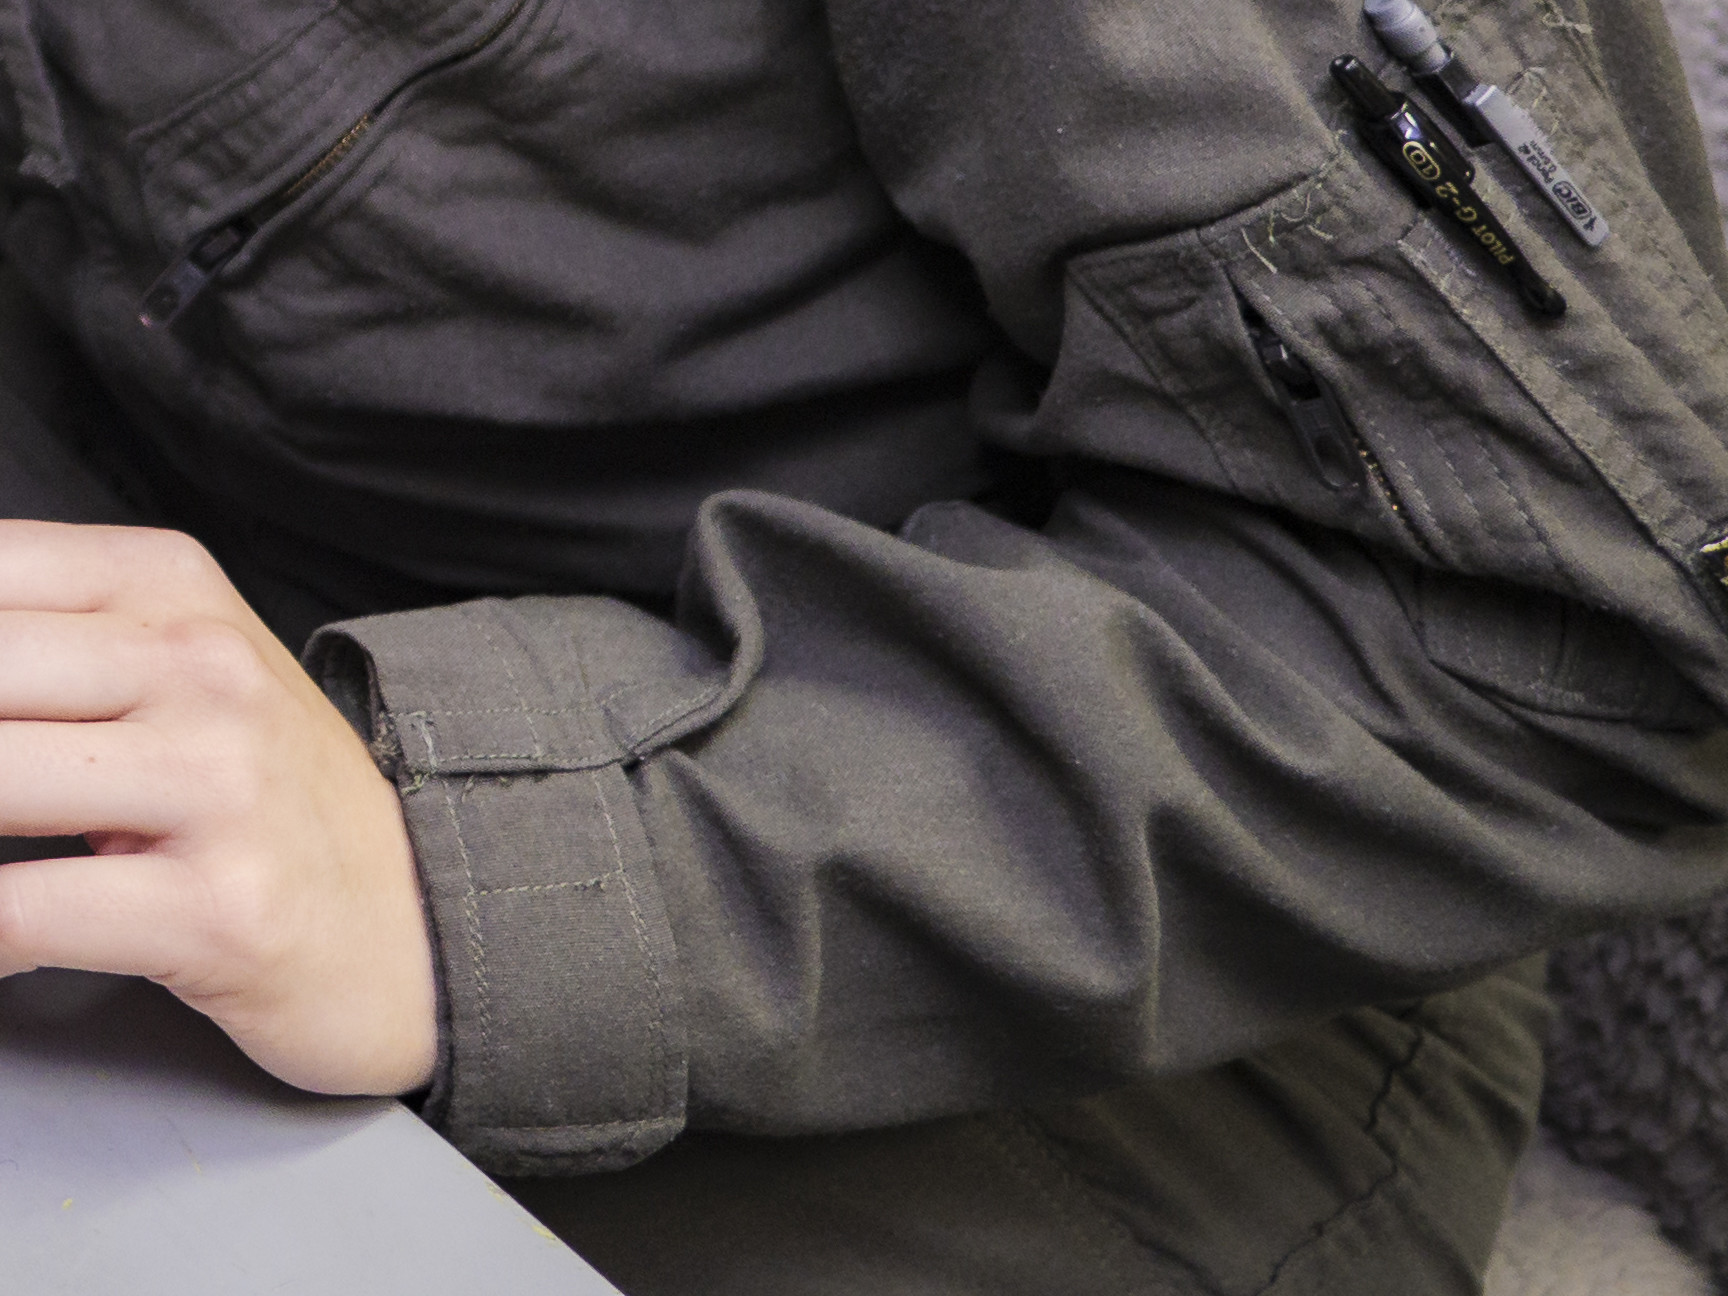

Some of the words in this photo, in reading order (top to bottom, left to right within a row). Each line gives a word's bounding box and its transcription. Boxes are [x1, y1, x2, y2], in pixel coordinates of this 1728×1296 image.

[1435, 180, 1479, 223] G-2
[1554, 183, 1588, 216] BIC
[1471, 224, 1515, 266] PILOT
